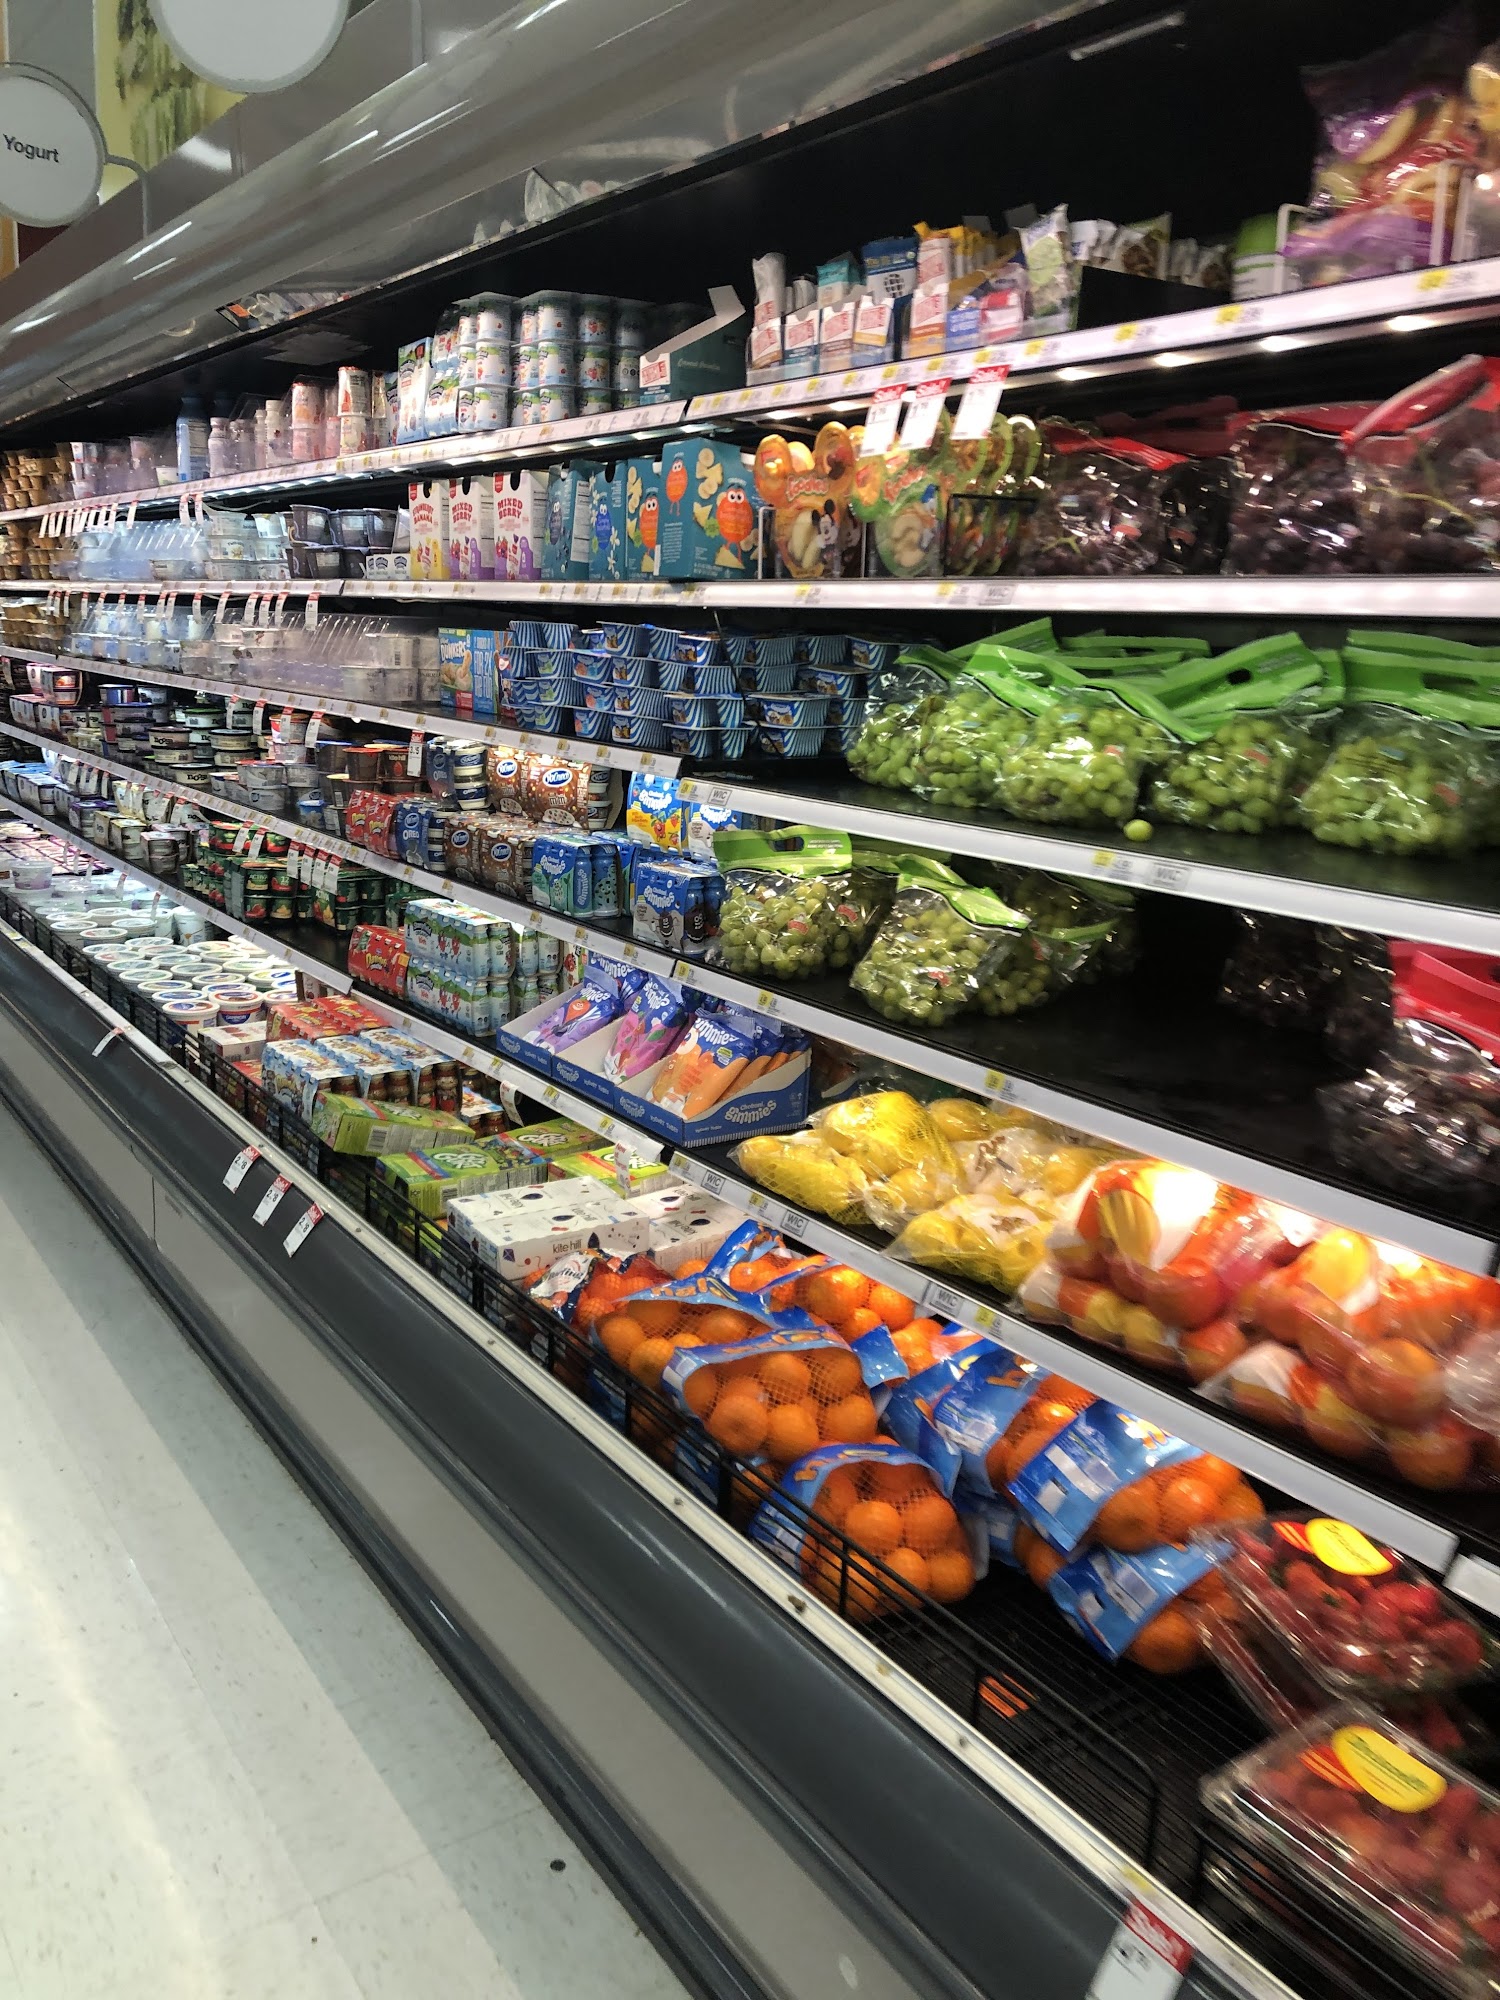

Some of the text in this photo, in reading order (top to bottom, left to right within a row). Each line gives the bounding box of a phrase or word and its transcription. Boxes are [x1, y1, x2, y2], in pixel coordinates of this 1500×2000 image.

[3, 133, 60, 163] Yogurt
[451, 502, 473, 514] MIXED
[497, 498, 523, 511] MIXED
[452, 513, 472, 523] BERRY
[498, 508, 522, 520] BERRY
[713, 790, 728, 800] WIC
[402, 830, 419, 840] OREO
[1156, 866, 1182, 882] WIC
[695, 1017, 740, 1045] immies
[706, 1173, 721, 1187] WIC
[788, 1214, 804, 1228] WIC
[552, 1238, 582, 1254] kite hill
[938, 1289, 958, 1307] WIC
